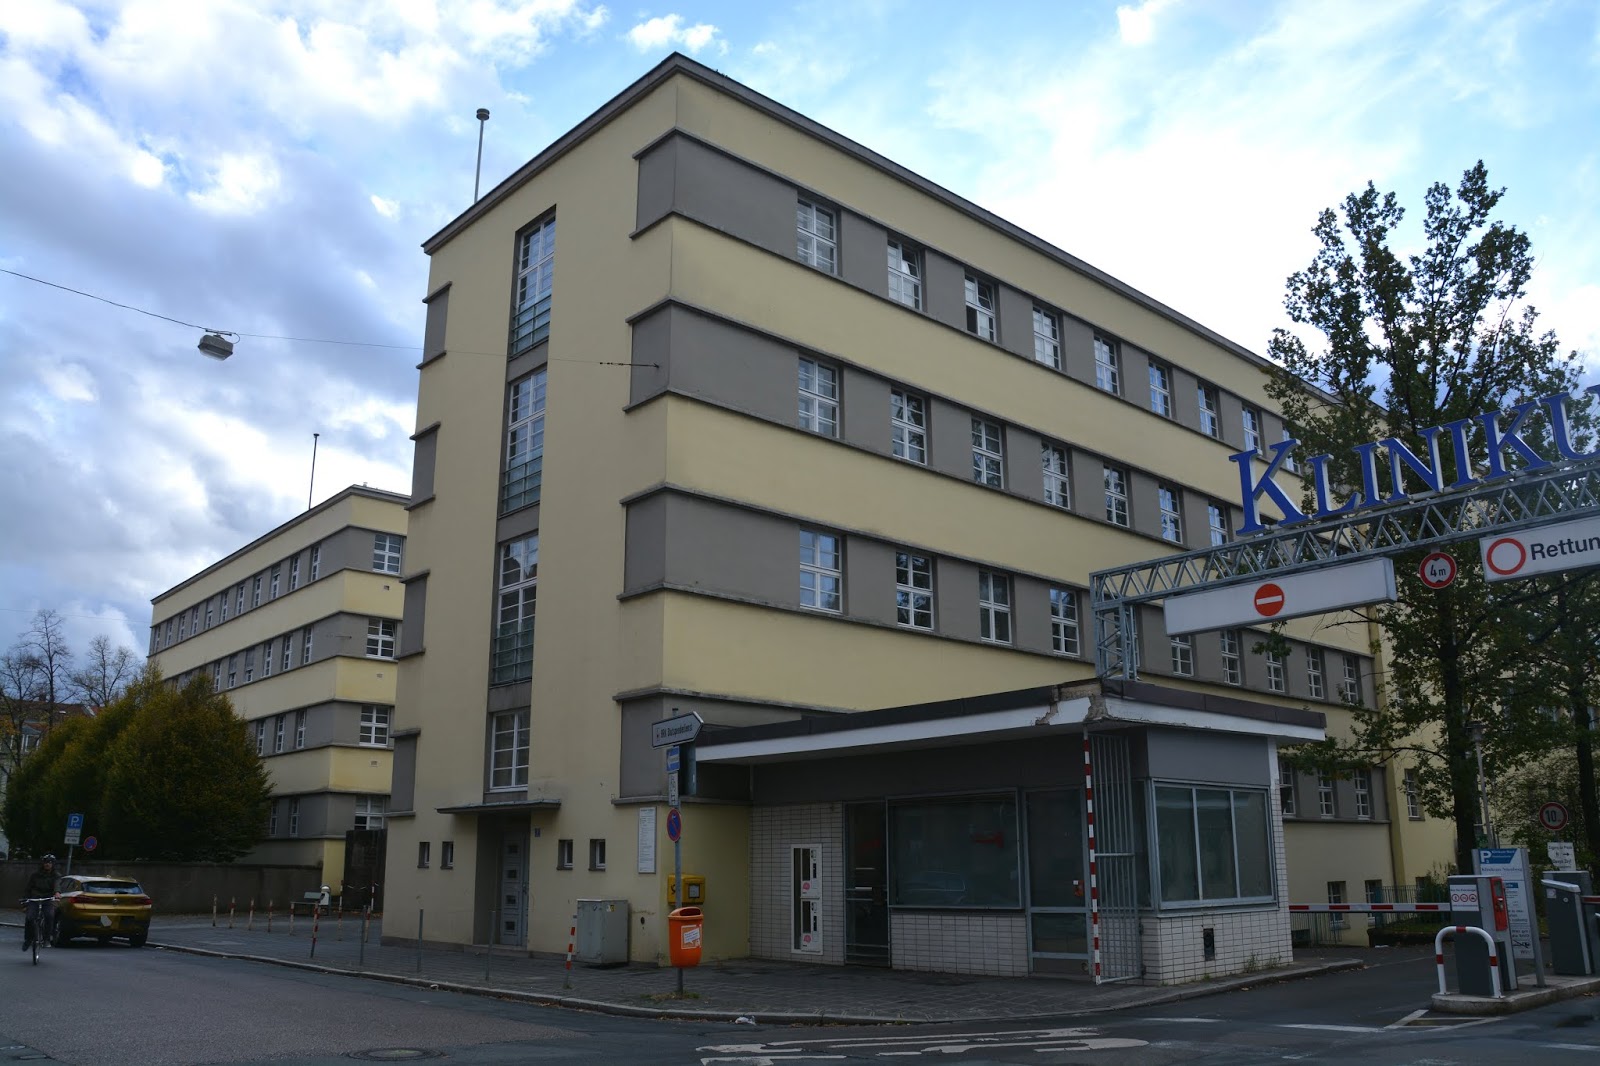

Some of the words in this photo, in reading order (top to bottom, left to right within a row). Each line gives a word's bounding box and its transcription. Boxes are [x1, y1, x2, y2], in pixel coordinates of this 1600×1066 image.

[1229, 384, 1600, 536] KLINIKU
[1530, 536, 1600, 561] Rettun
[70, 816, 80, 827] P
[1545, 810, 1556, 823] 10
